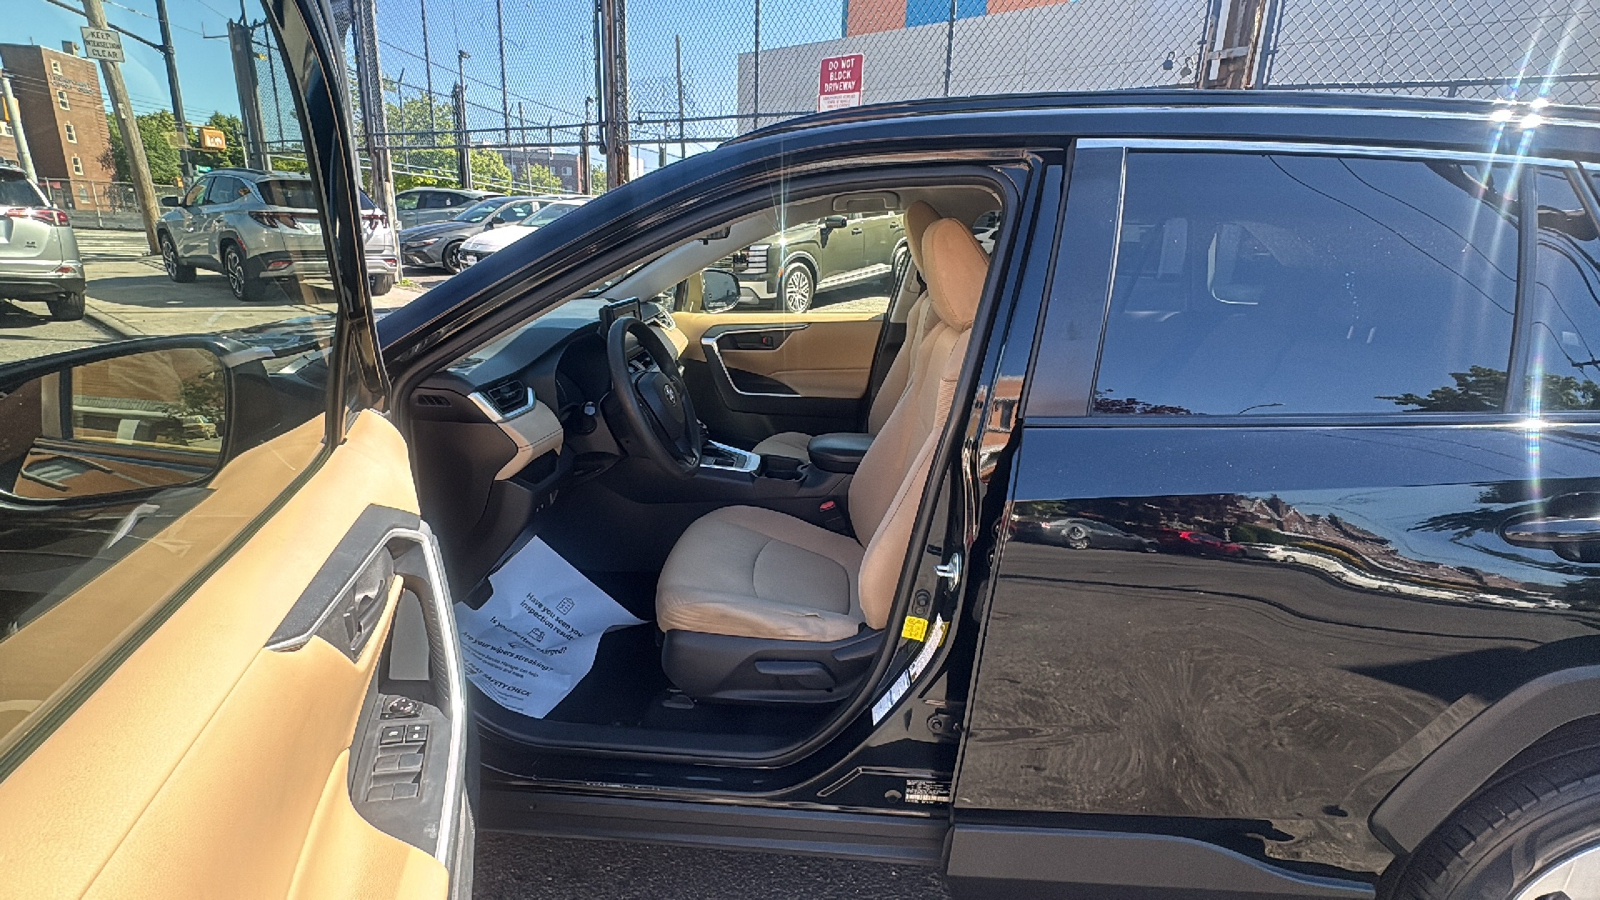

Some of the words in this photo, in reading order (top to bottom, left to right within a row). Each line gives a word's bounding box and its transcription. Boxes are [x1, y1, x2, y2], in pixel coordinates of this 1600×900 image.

[90, 31, 111, 40] KEEP
[92, 48, 118, 59] CLEAR
[828, 60, 839, 71] DO
[841, 58, 855, 69] NOT
[829, 69, 852, 81] BLOCK
[824, 80, 857, 93] DRIVEWAY
[526, 592, 543, 609] Have
[541, 606, 555, 619] you
[554, 616, 571, 630] seen
[490, 616, 497, 624] Is
[495, 622, 512, 632] your
[472, 639, 491, 648] your
[491, 645, 515, 657] wipers
[514, 655, 553, 672] streaking?
[482, 673, 508, 689] SAFETY
[506, 685, 532, 697] CHECK
